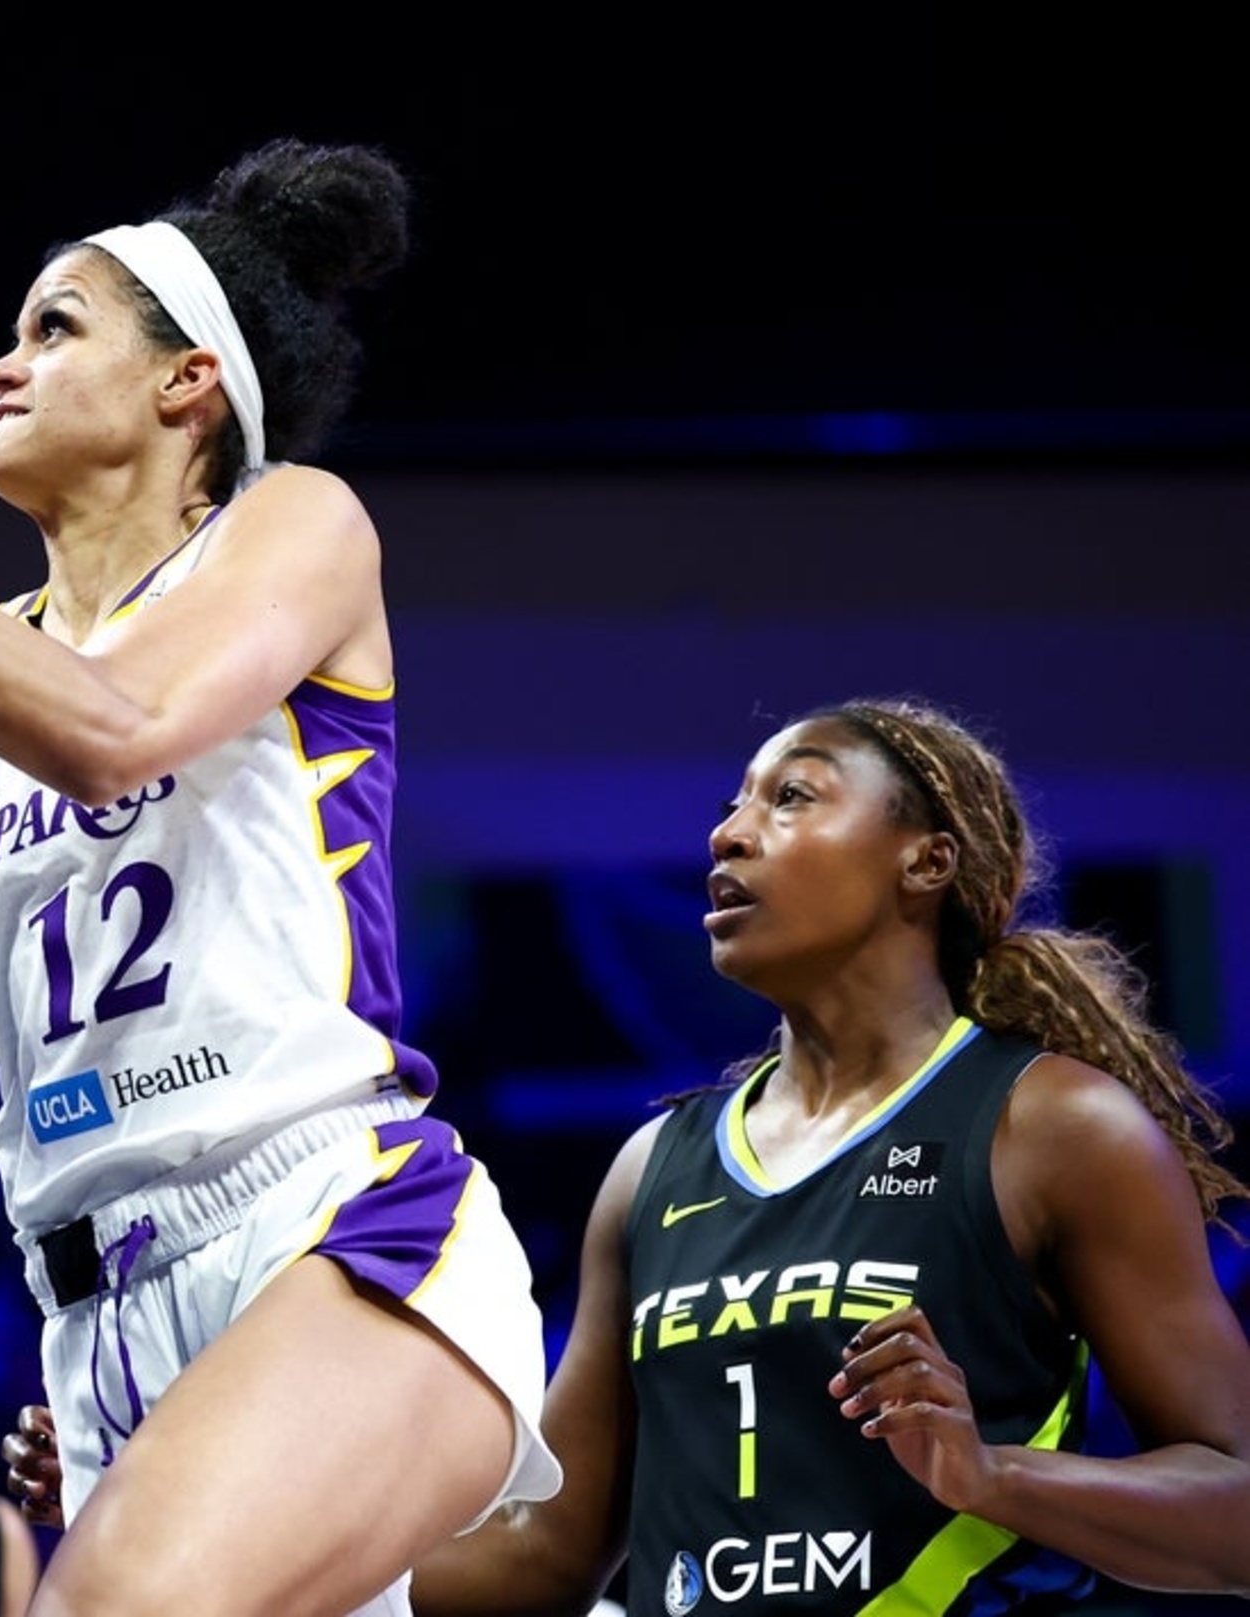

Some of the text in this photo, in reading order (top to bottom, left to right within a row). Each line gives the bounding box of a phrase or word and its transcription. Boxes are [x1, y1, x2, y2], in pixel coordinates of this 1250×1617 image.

[28, 861, 174, 1045] 12
[34, 1046, 232, 1129] UCLA Health
[860, 1175, 938, 1197] Albert
[632, 1259, 920, 1362] TEXAS
[726, 1363, 757, 1499] 1
[705, 1530, 872, 1603] GEM
